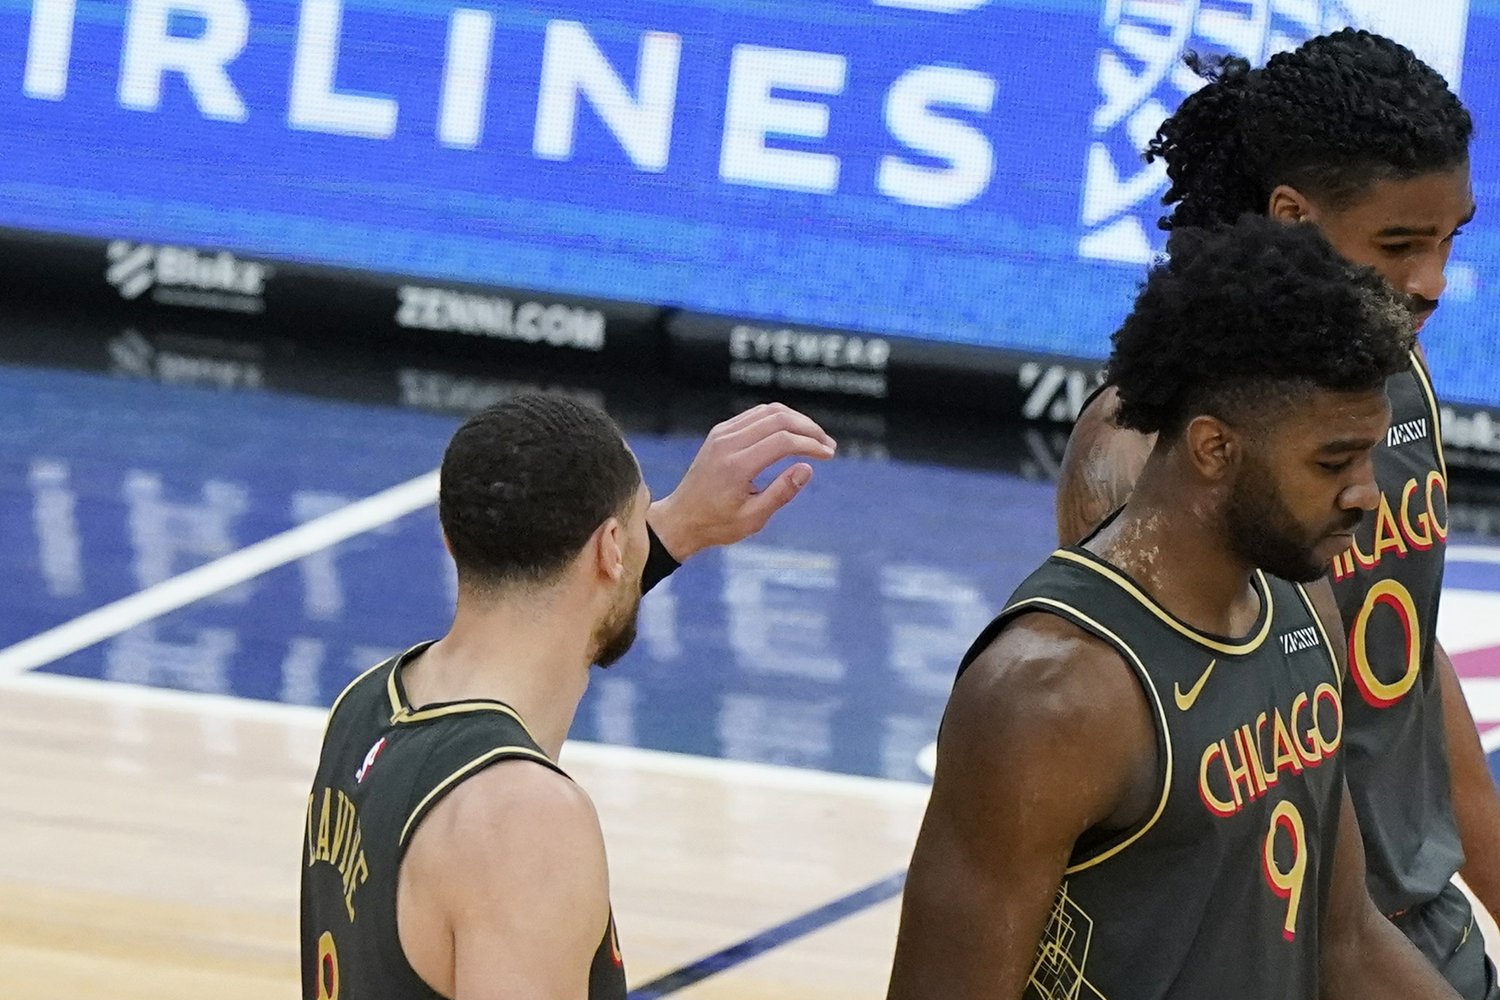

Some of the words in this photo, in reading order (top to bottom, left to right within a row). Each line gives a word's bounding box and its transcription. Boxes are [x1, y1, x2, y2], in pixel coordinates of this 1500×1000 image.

[24, 0, 998, 208] IRLINES
[396, 285, 605, 350] ZENNI.COM
[729, 324, 890, 369] EYEWEAR
[1348, 578, 1420, 708] 0
[1199, 682, 1343, 817] CHICAGO
[1262, 800, 1307, 941] 9
